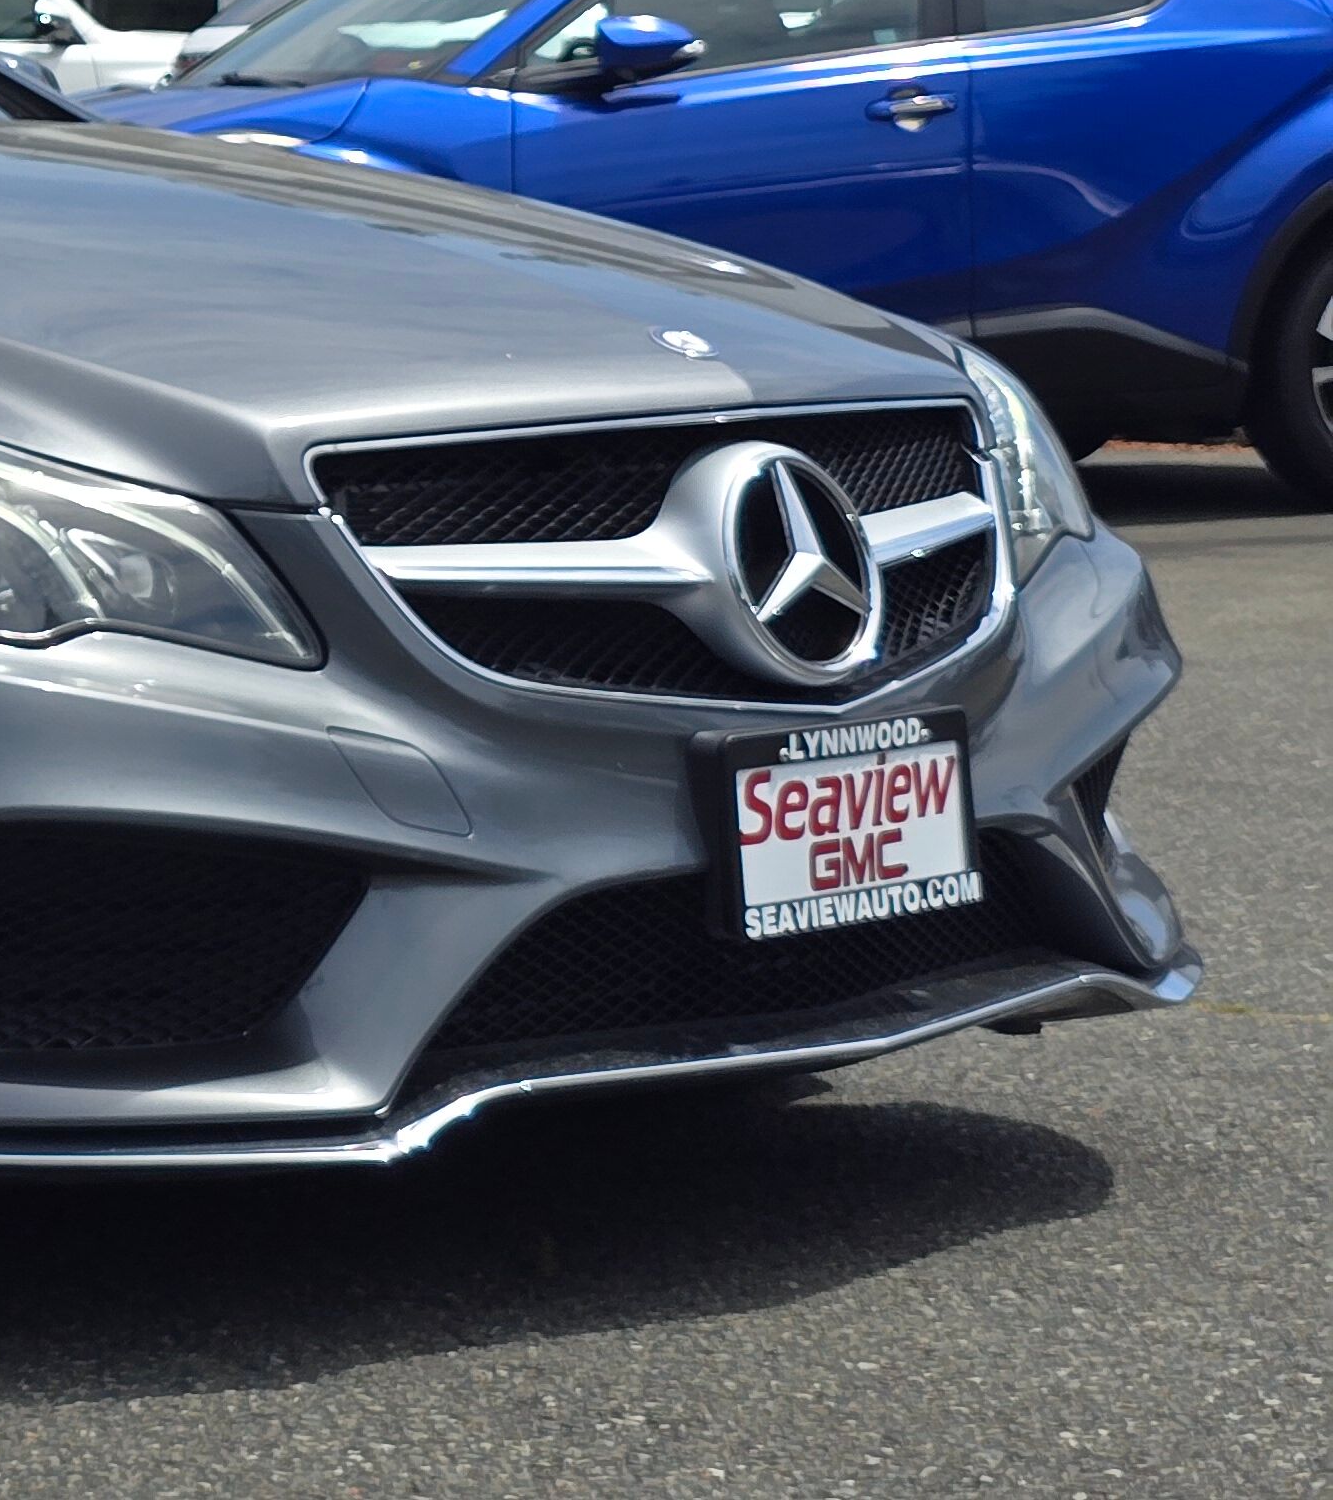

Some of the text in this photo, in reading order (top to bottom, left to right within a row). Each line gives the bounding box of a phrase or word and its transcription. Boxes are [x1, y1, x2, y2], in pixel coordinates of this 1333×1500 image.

[789, 717, 921, 761] LYNNWOOD
[739, 752, 956, 846] Seaview
[808, 828, 909, 892] GMC
[744, 871, 982, 939] SEAVIEWAUTO.COM
